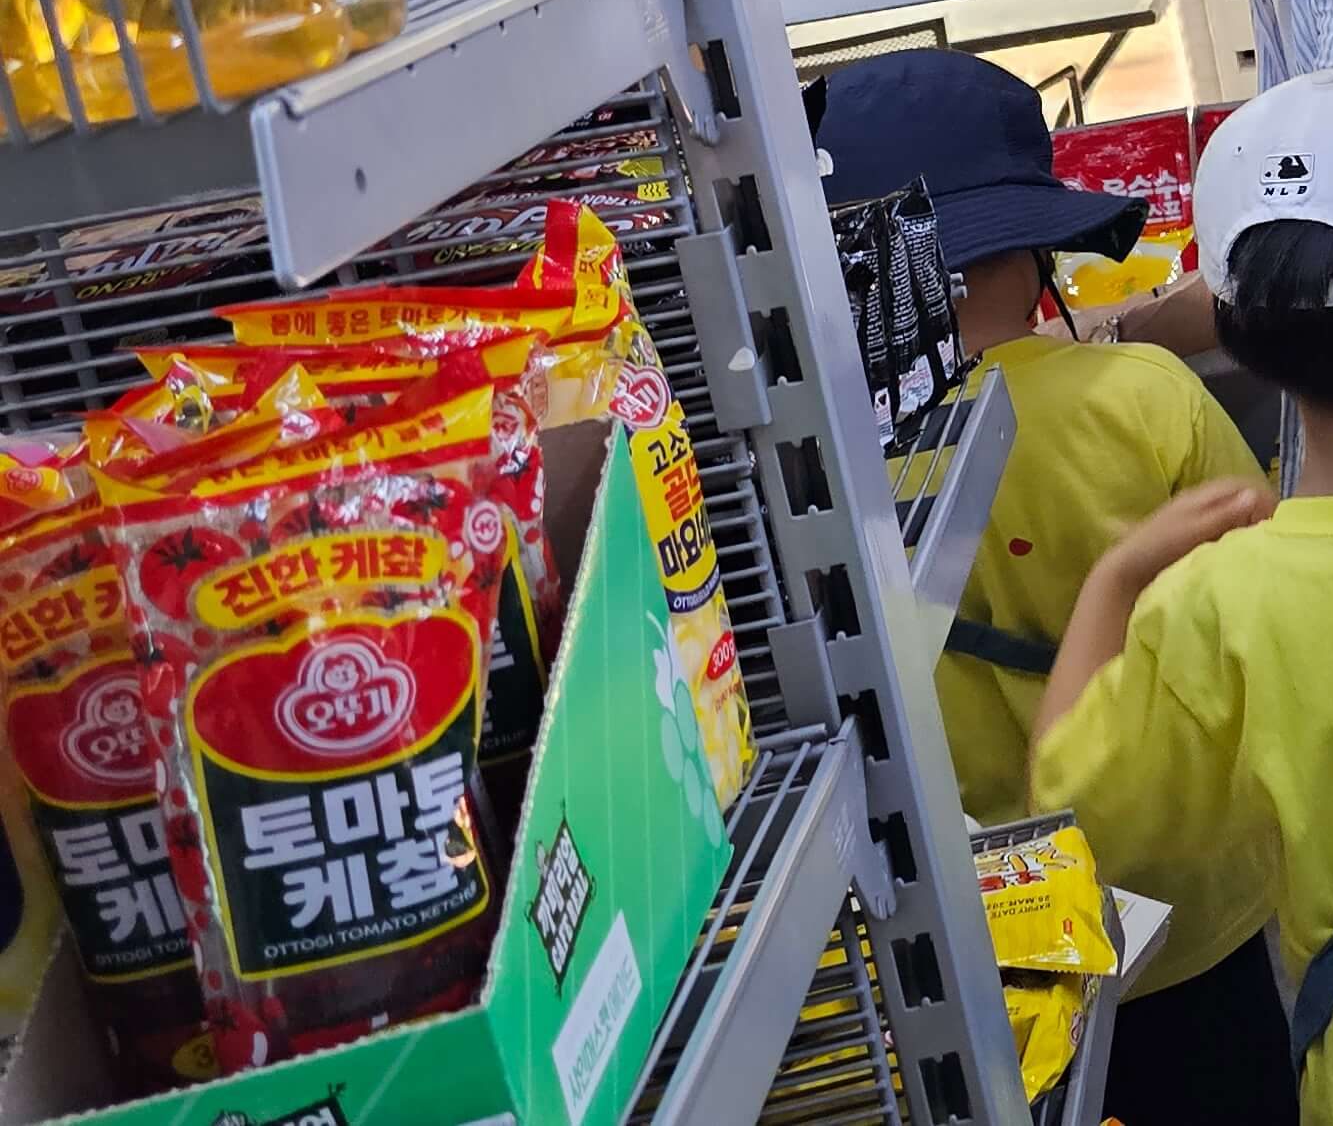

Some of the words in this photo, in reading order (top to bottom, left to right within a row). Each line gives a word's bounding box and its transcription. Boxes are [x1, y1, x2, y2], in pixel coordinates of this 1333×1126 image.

[326, 309, 370, 336] 좋은
[213, 550, 322, 611] 진한
[330, 534, 430, 584] 케찹
[303, 689, 394, 736] 오뚜기
[89, 729, 146, 766] 오뚜
[240, 750, 468, 872] 토마토
[281, 836, 464, 931] 케찹
[263, 934, 336, 960] OTTOGI
[339, 913, 419, 947] TOMATO
